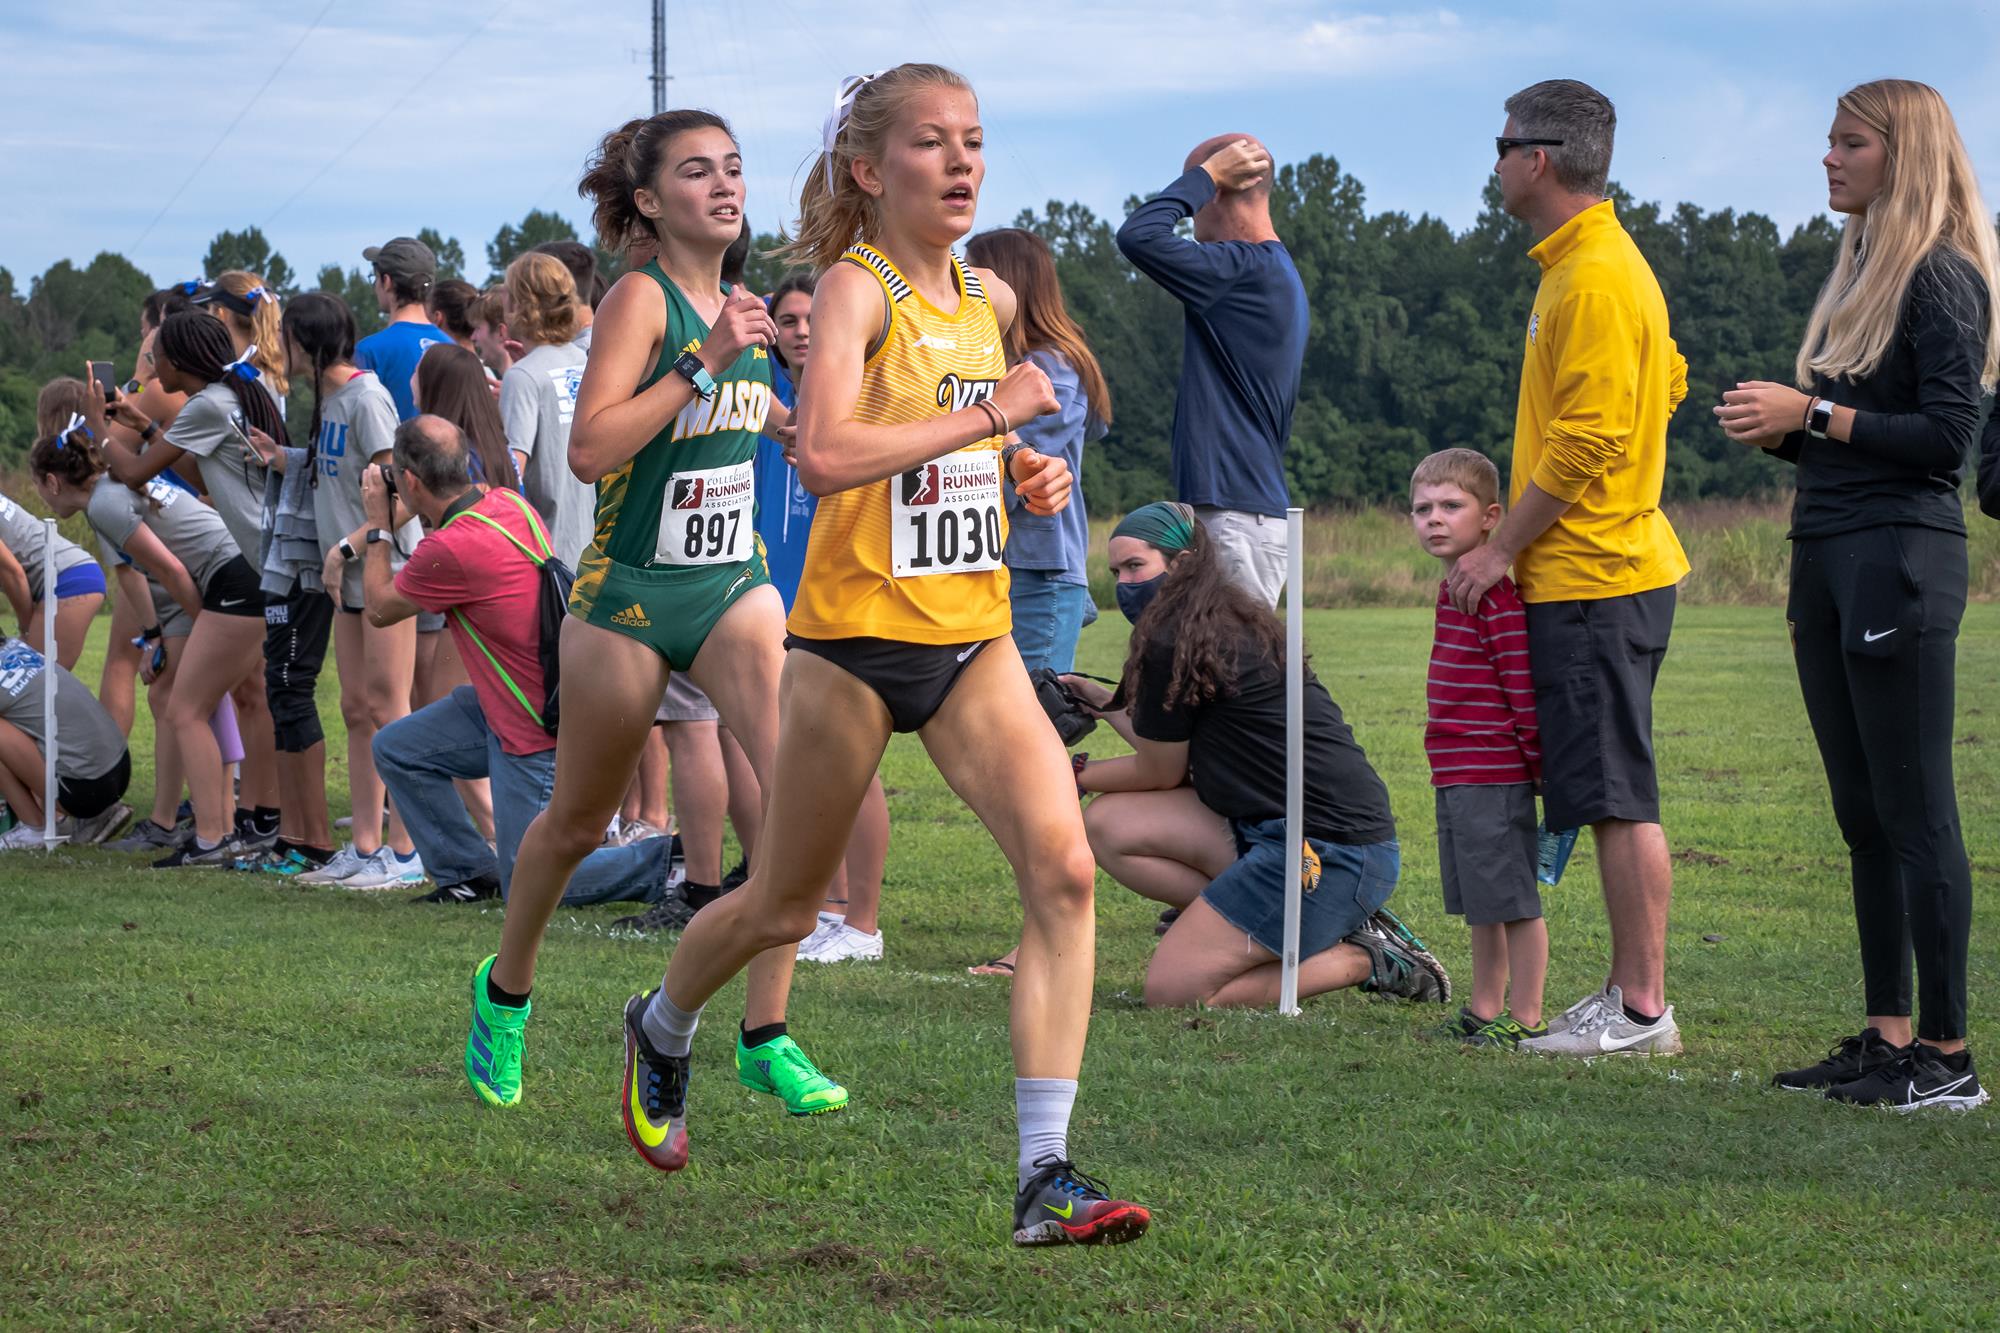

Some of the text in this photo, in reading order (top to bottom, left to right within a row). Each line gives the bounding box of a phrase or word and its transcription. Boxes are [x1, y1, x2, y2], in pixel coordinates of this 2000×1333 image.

[671, 380, 771, 443] MASO
[706, 479, 751, 498] RUNNING
[943, 472, 997, 490] RUNNING
[704, 495, 751, 508] ASSOCIATION
[944, 491, 999, 504] ASSOCIATION
[684, 509, 741, 558] 897
[910, 505, 1001, 569] 1030
[610, 615, 651, 627] adidas
